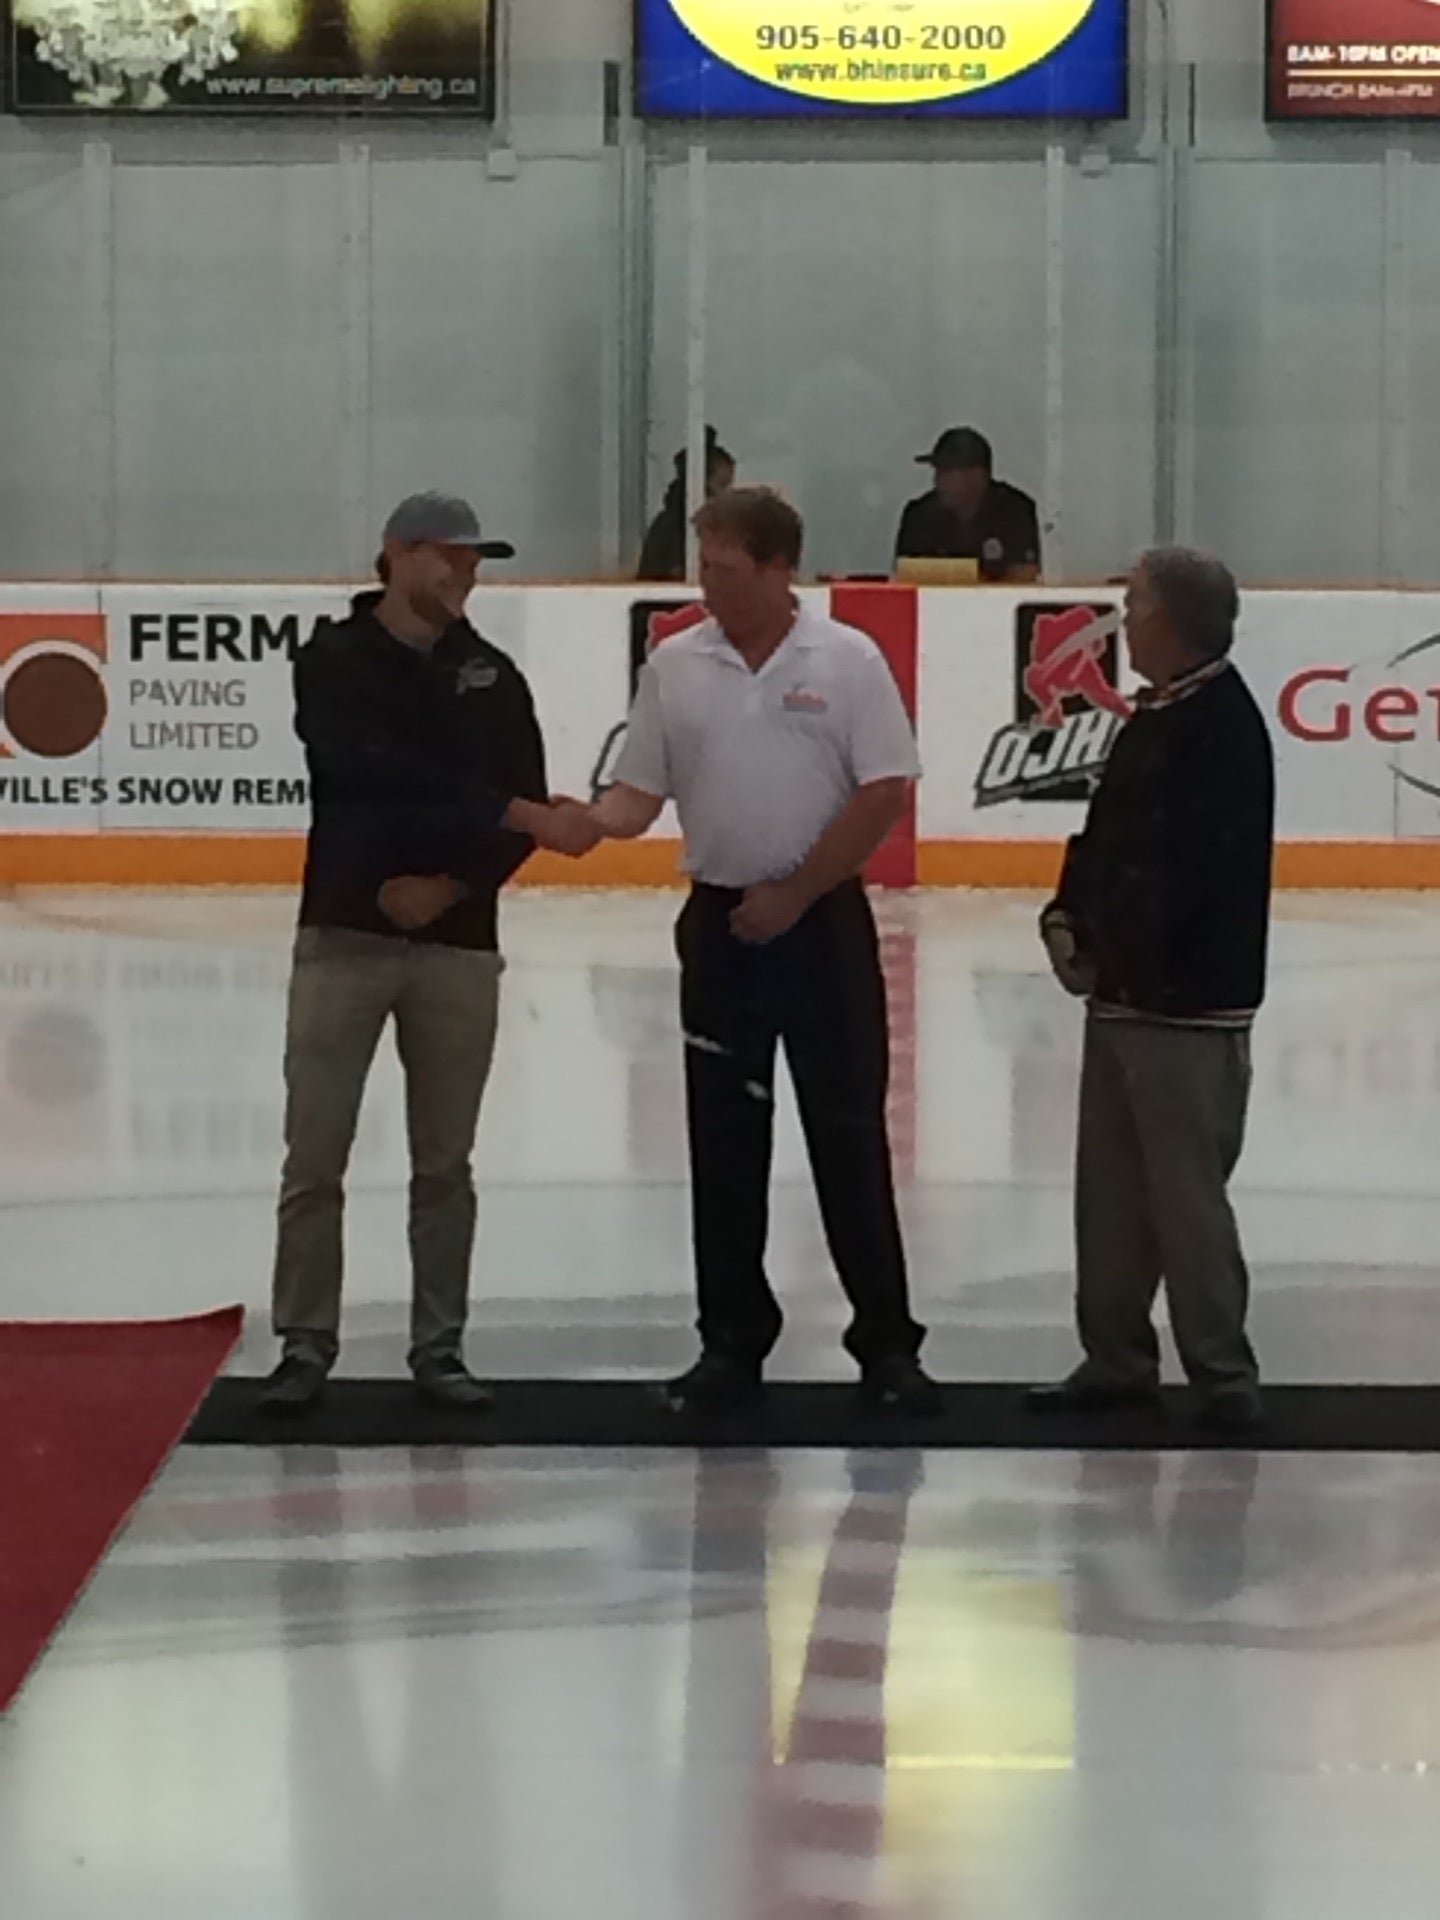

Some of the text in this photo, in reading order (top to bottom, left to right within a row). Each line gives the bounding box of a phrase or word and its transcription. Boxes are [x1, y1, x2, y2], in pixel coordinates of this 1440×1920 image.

[756, 25, 1006, 50] 905-640-2000
[775, 59, 986, 81] www.bhinsure.ca
[130, 679, 246, 706] PAVING
[130, 722, 258, 749] LIMITED
[982, 710, 1127, 788] OJH
[117, 777, 222, 805] SNOW
[233, 778, 307, 805] REM
